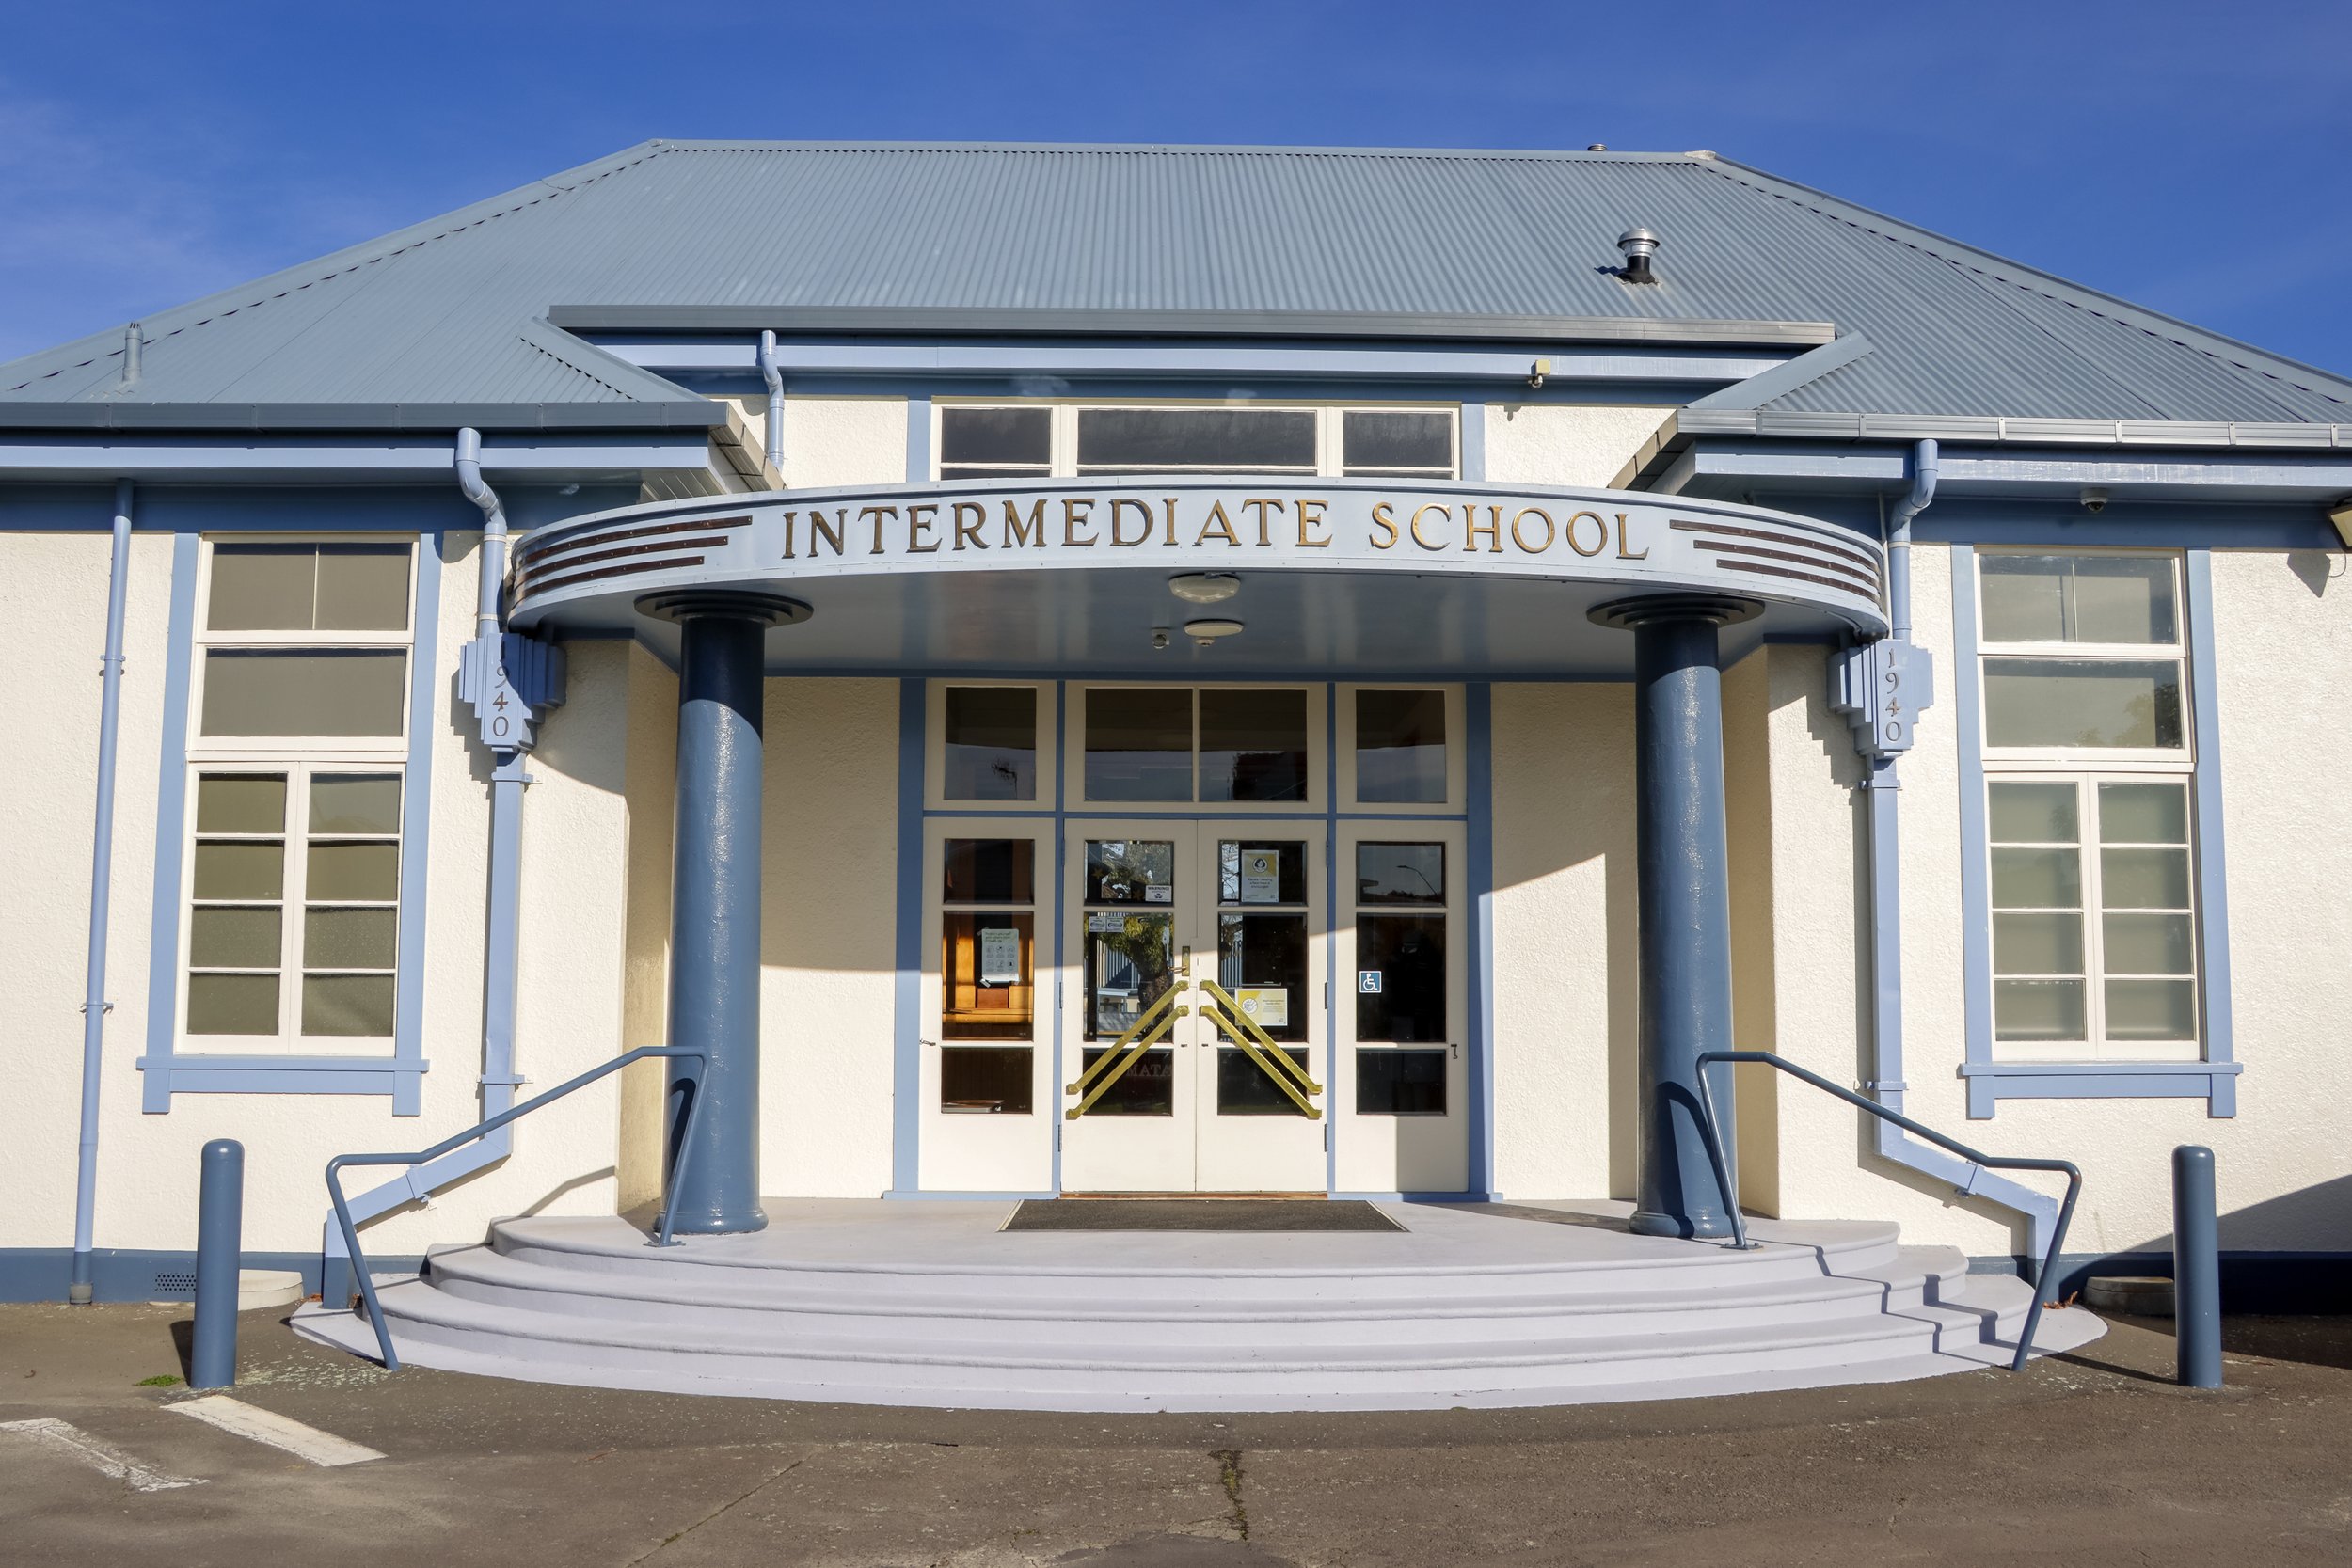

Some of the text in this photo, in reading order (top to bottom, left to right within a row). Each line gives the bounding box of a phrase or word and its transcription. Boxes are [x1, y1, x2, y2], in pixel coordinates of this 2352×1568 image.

[782, 498, 1650, 560] INTERMEDIATE SCHOOL
[492, 641, 510, 736] 1940
[1885, 648, 1902, 741] 1940
